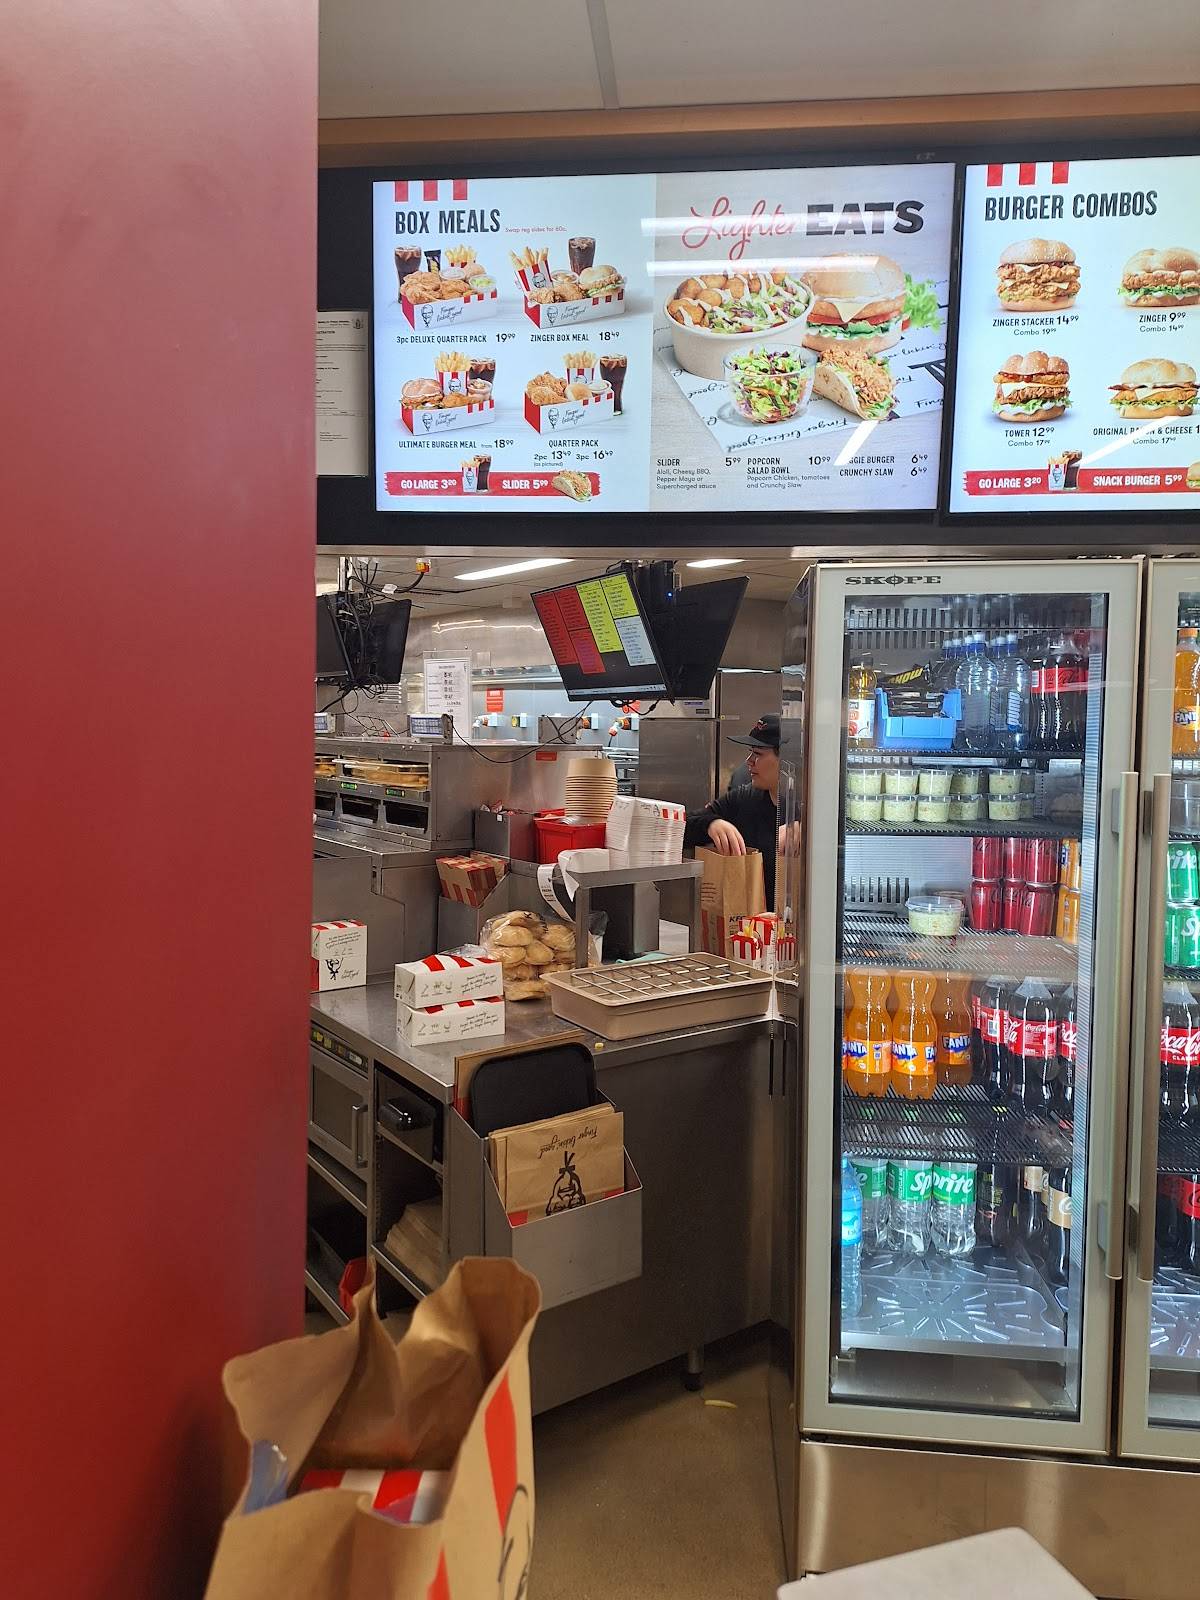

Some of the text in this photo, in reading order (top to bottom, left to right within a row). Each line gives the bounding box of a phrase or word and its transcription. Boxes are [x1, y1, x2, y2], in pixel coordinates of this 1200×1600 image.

[985, 190, 1157, 221] BURGER COMBOS
[395, 208, 501, 235] BOX MEALS
[681, 196, 925, 261] Lighter EATS
[993, 317, 1020, 327] ZINGER
[1021, 316, 1054, 327] STACKER
[1139, 314, 1167, 323] ZINGER
[1013, 328, 1040, 336] Combo
[1139, 325, 1166, 333] Combo
[396, 336, 409, 345] 3pc
[410, 335, 436, 344] DELUXE
[436, 335, 468, 344] QUARTER
[469, 335, 487, 343] PACK
[530, 334, 555, 343] ZINGER
[556, 334, 570, 342] BOX
[572, 333, 590, 342] MEAL
[914, 398, 944, 409] Fing
[1005, 428, 1030, 438] TOWER
[1093, 427, 1128, 436] ORIGINAL
[1157, 427, 1163, 435] &
[1164, 427, 1193, 435] CHEESE
[399, 440, 430, 449] ULTIMATE
[431, 440, 457, 449] BURGER
[459, 440, 477, 449] MEAL
[549, 439, 599, 448] QUARTER PACK
[534, 453, 548, 461] 2pc
[575, 453, 590, 461] 3pc
[747, 457, 781, 466] POPCORN
[866, 456, 895, 464] BURGER
[656, 458, 681, 467] SLIDER
[672, 468, 696, 477] Cheesy
[747, 466, 790, 475] SALAD BOWL
[839, 468, 873, 477] CRUNCHY
[874, 468, 894, 476] SLAW
[747, 475, 772, 483] Popcorn
[773, 474, 800, 482] Chicken,
[1093, 476, 1124, 486] SNACK
[1124, 475, 1161, 486] BURGER
[401, 479, 413, 490] GO
[413, 479, 439, 490] LARGE
[502, 479, 530, 490] SLIDER
[656, 483, 698, 491] Supercharged
[760, 482, 786, 490] Crunchy
[978, 479, 992, 489] GO
[993, 478, 1021, 489] LARGE
[845, 574, 942, 586] SKOPE
